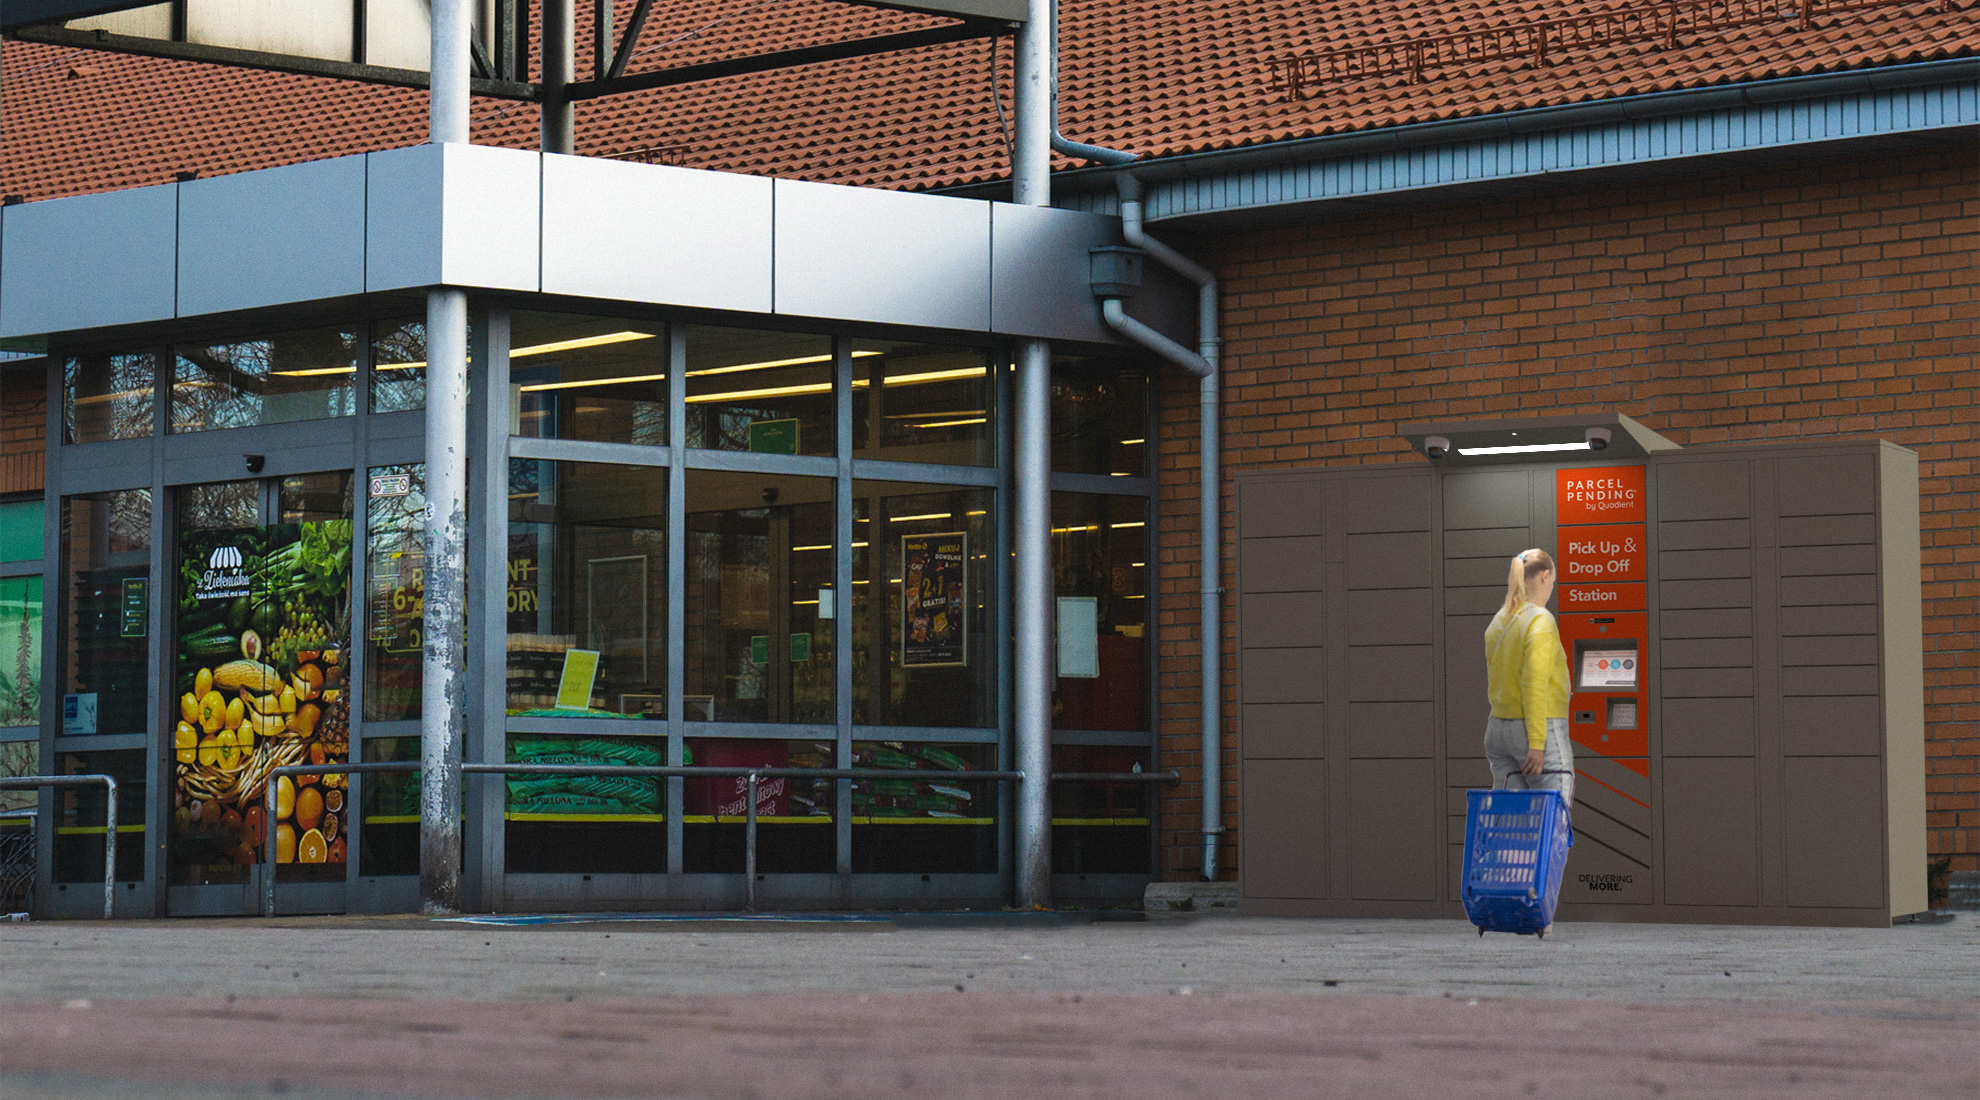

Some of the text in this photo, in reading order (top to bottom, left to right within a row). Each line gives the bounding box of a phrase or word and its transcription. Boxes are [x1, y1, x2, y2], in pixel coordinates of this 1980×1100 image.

[1567, 479, 1623, 490] PARCEL
[1567, 489, 1634, 501] PENDING
[1586, 501, 1634, 511] by Quadient
[1569, 537, 1637, 556] Pick Up &
[1569, 559, 1631, 576] Drop Off
[1569, 588, 1618, 602] Station
[1578, 874, 1633, 883] DELIVERING
[1589, 882, 1622, 891] MORE.
